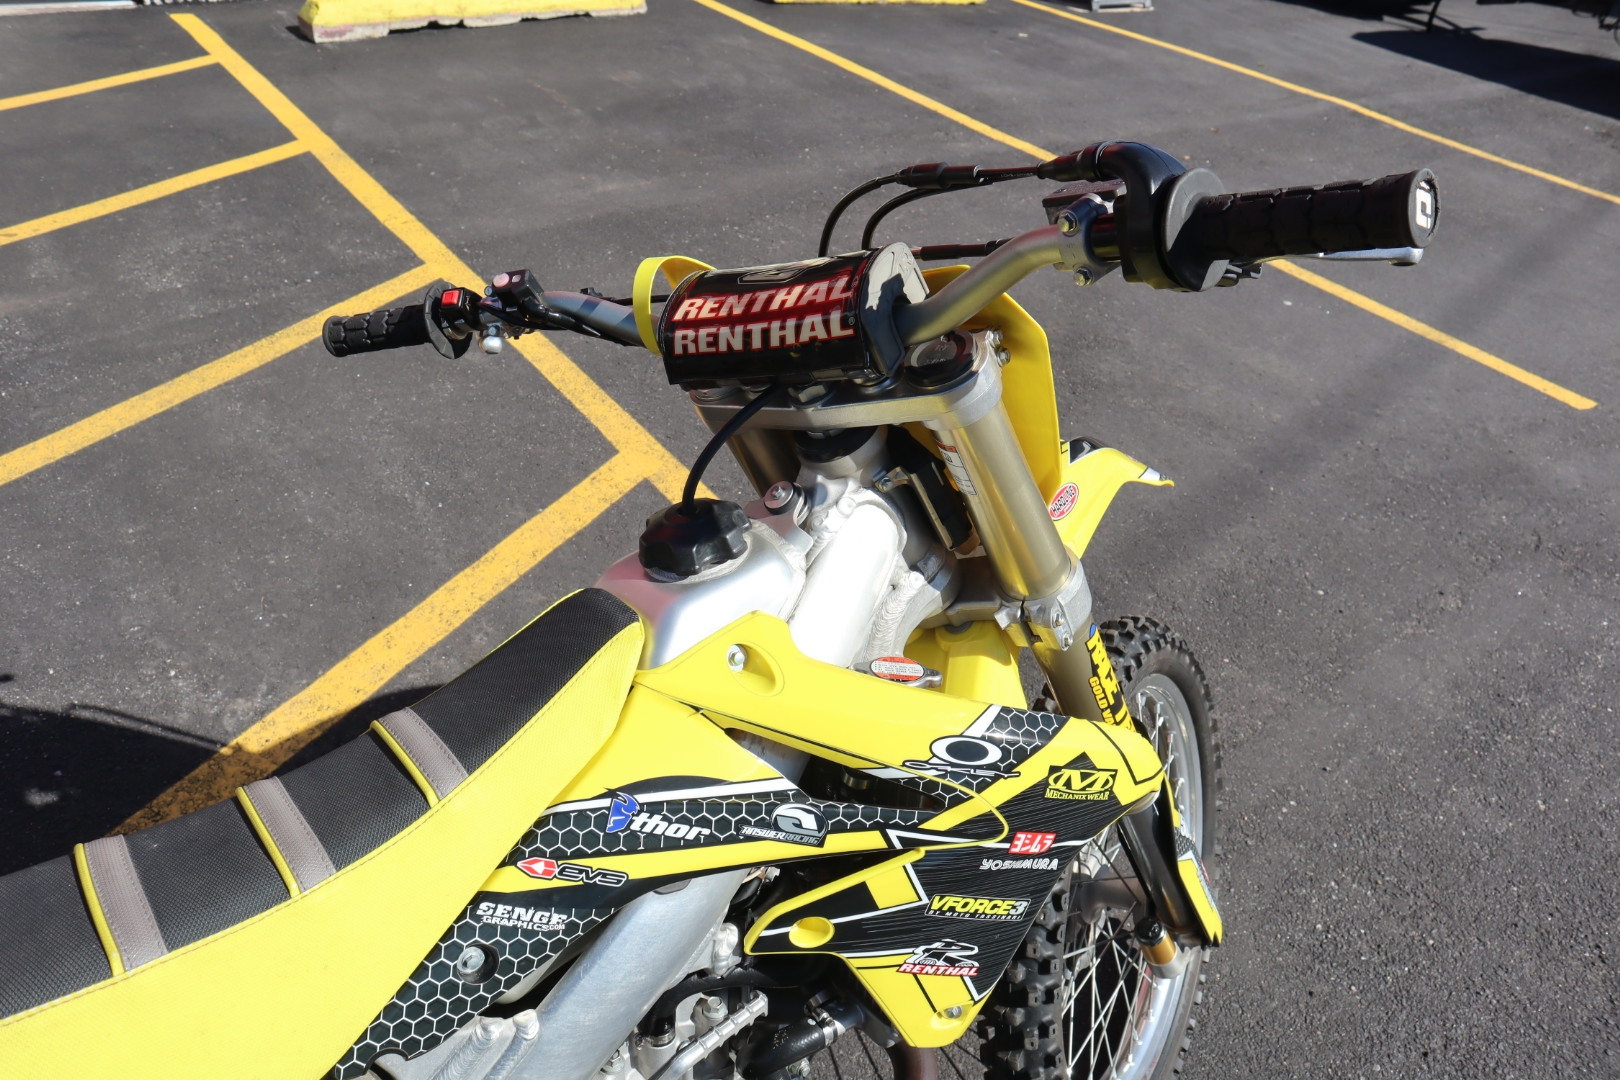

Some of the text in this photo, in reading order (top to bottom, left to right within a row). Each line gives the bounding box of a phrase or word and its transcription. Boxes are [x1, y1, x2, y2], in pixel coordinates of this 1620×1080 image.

[673, 275, 852, 322] RENTHAL
[673, 309, 855, 355] RENTHAL
[1089, 676, 1108, 709] GOLD
[1045, 788, 1110, 801] MECHANIX WEAR
[630, 812, 711, 840] thor
[979, 857, 1059, 871] YOSHIMURA
[898, 963, 979, 976] RENTHAL
